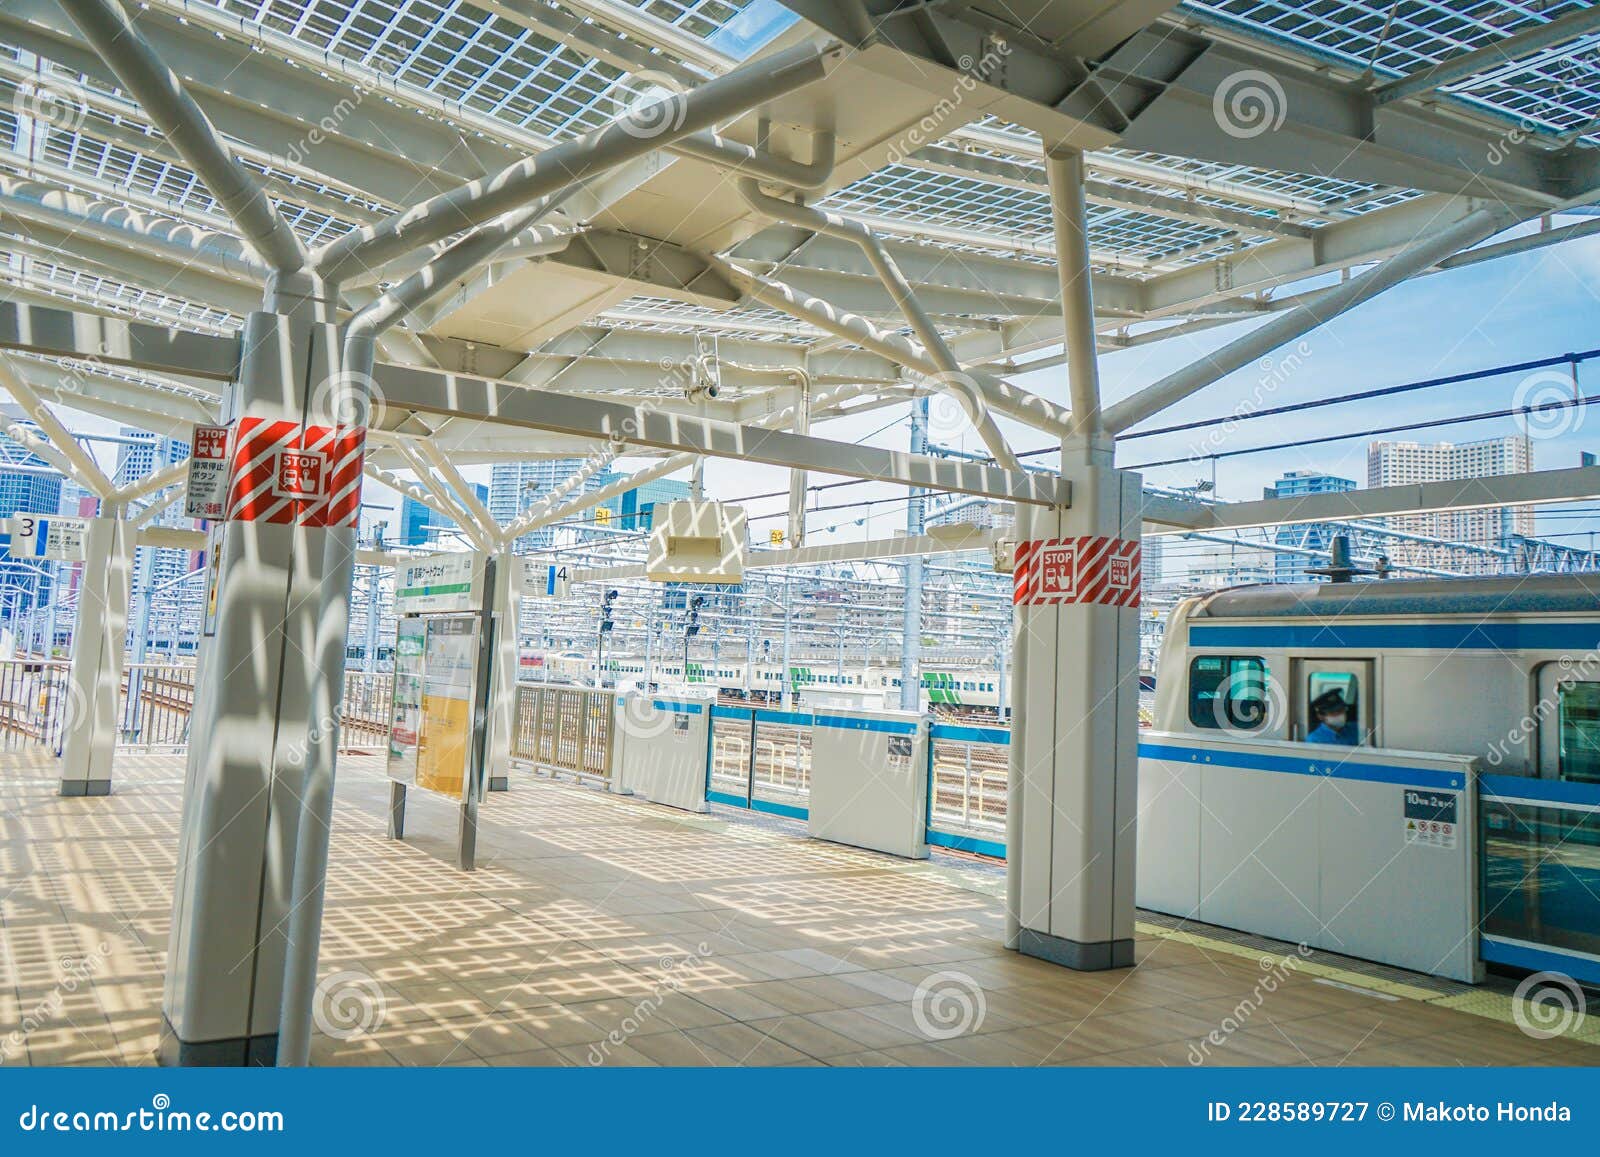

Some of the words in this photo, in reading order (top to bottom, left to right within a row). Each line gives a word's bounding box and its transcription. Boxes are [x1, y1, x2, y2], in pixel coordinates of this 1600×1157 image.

[198, 430, 226, 439] STOP
[283, 455, 318, 468] STOP
[191, 471, 216, 480] ボタン
[20, 518, 34, 537] 3
[1045, 552, 1072, 564] STOP
[1112, 560, 1129, 569] STOP
[557, 566, 568, 581] 4
